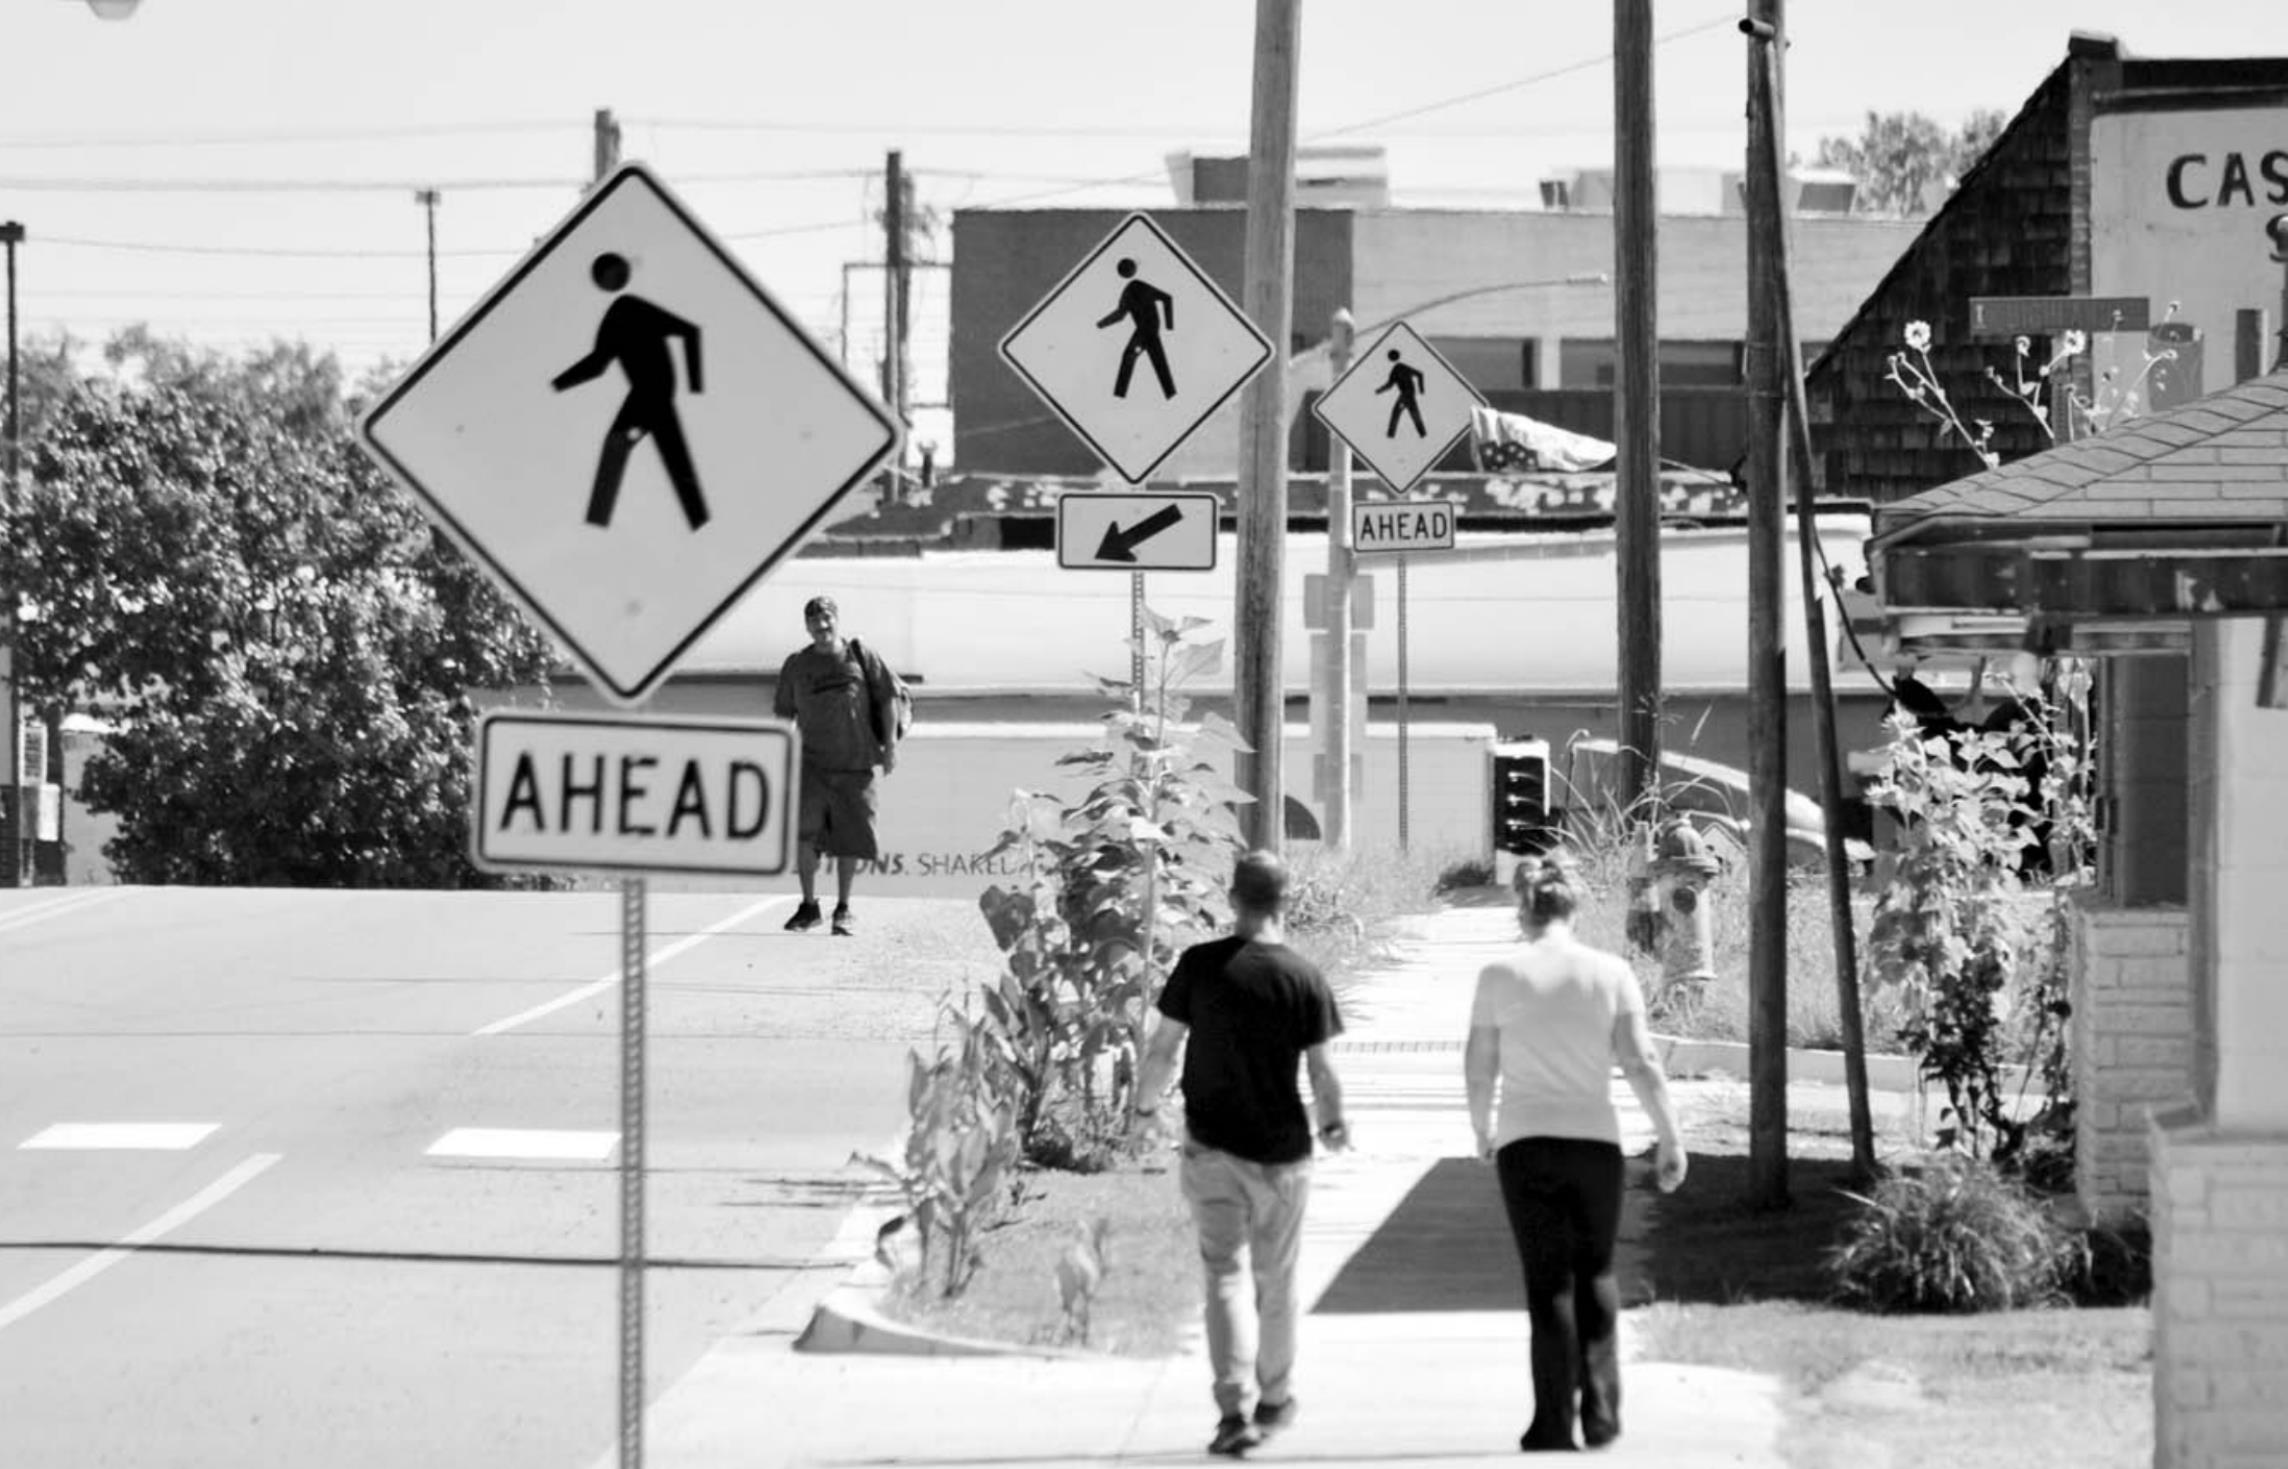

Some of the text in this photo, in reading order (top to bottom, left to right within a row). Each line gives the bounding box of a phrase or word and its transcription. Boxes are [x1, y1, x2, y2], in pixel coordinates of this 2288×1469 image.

[2166, 150, 2288, 210] CAS
[1360, 512, 1448, 541] AHEAD
[499, 751, 771, 840] AHEAD
